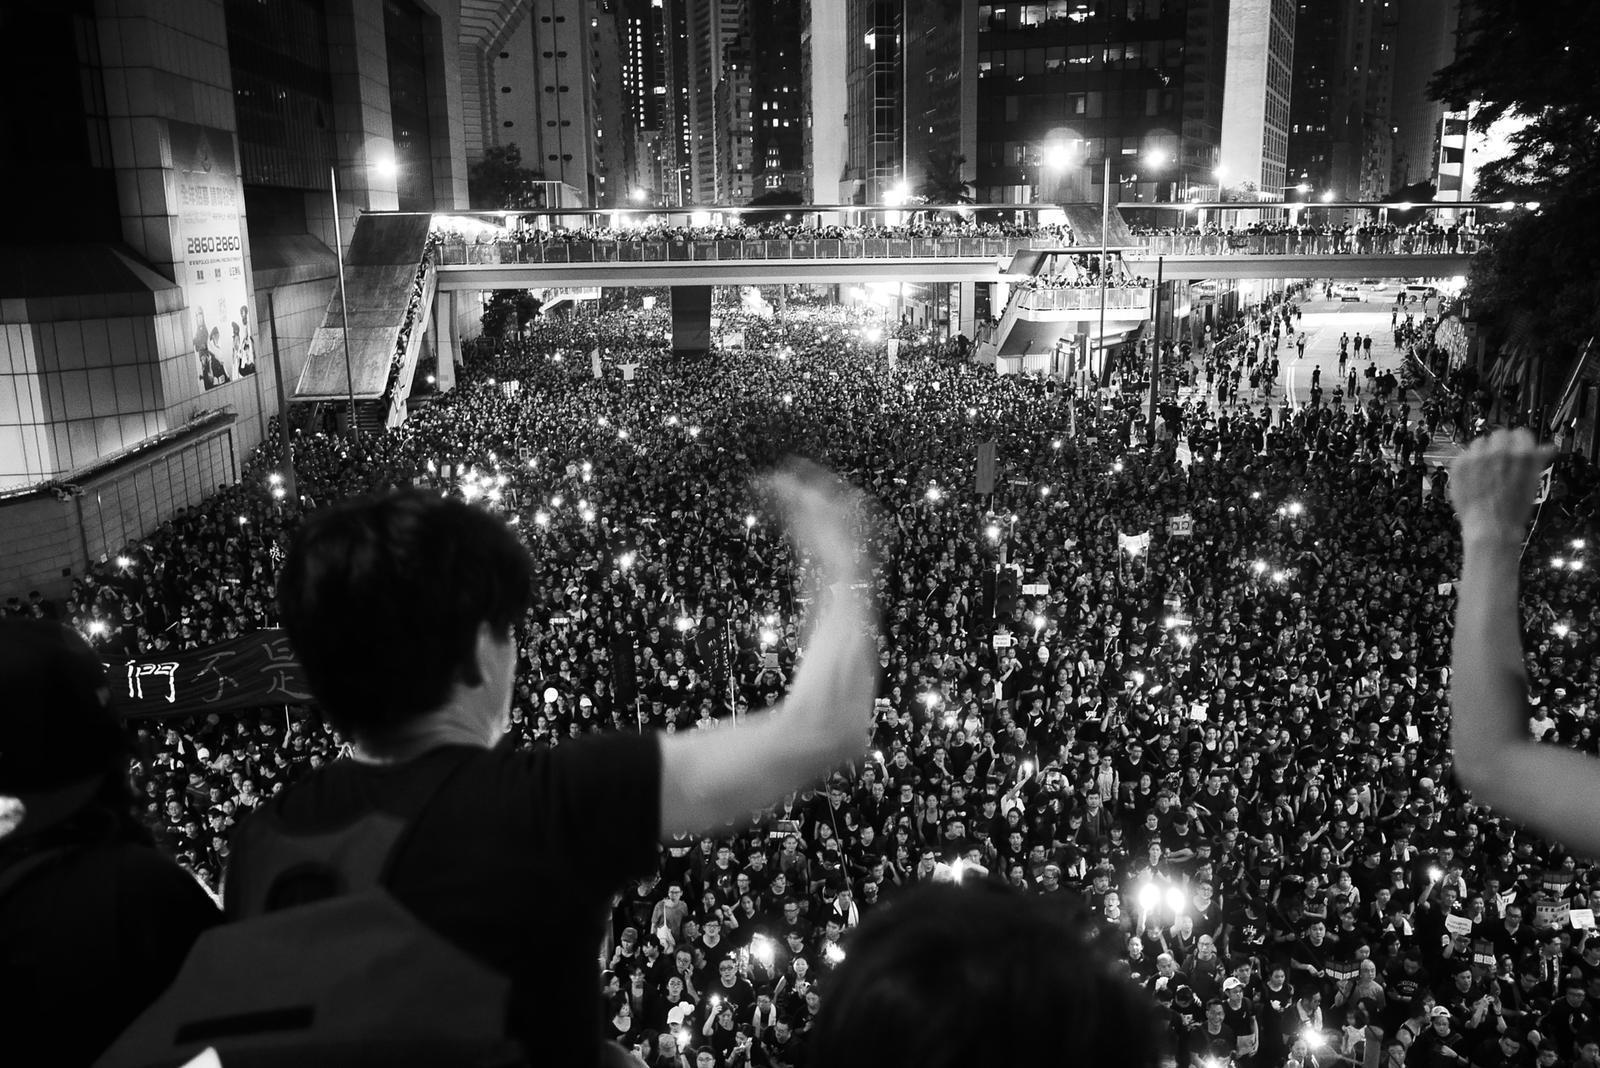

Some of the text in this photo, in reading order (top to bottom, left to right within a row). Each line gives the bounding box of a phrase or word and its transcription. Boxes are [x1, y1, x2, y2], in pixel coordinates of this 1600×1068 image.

[187, 235, 241, 255] 2860 2860
[101, 637, 314, 704] 們不是
